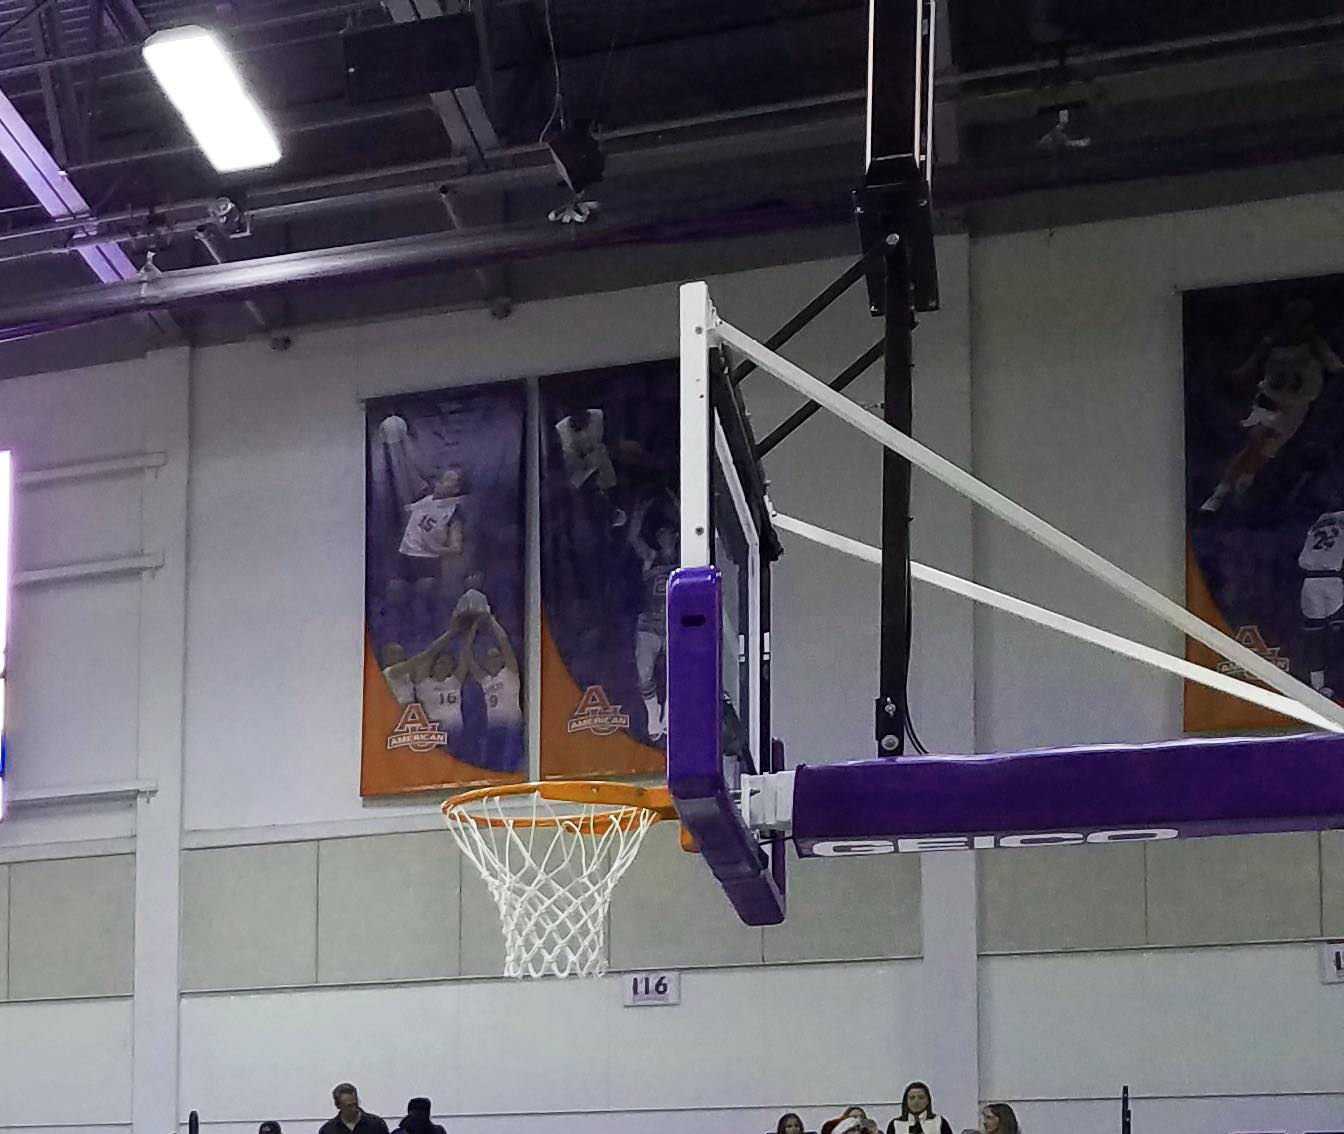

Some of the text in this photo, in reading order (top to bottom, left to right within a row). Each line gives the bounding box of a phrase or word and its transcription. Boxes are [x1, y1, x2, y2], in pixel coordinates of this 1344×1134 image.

[390, 732, 445, 746] AMERICAN
[812, 828, 1179, 857] GEICO
[633, 976, 667, 995] 116
